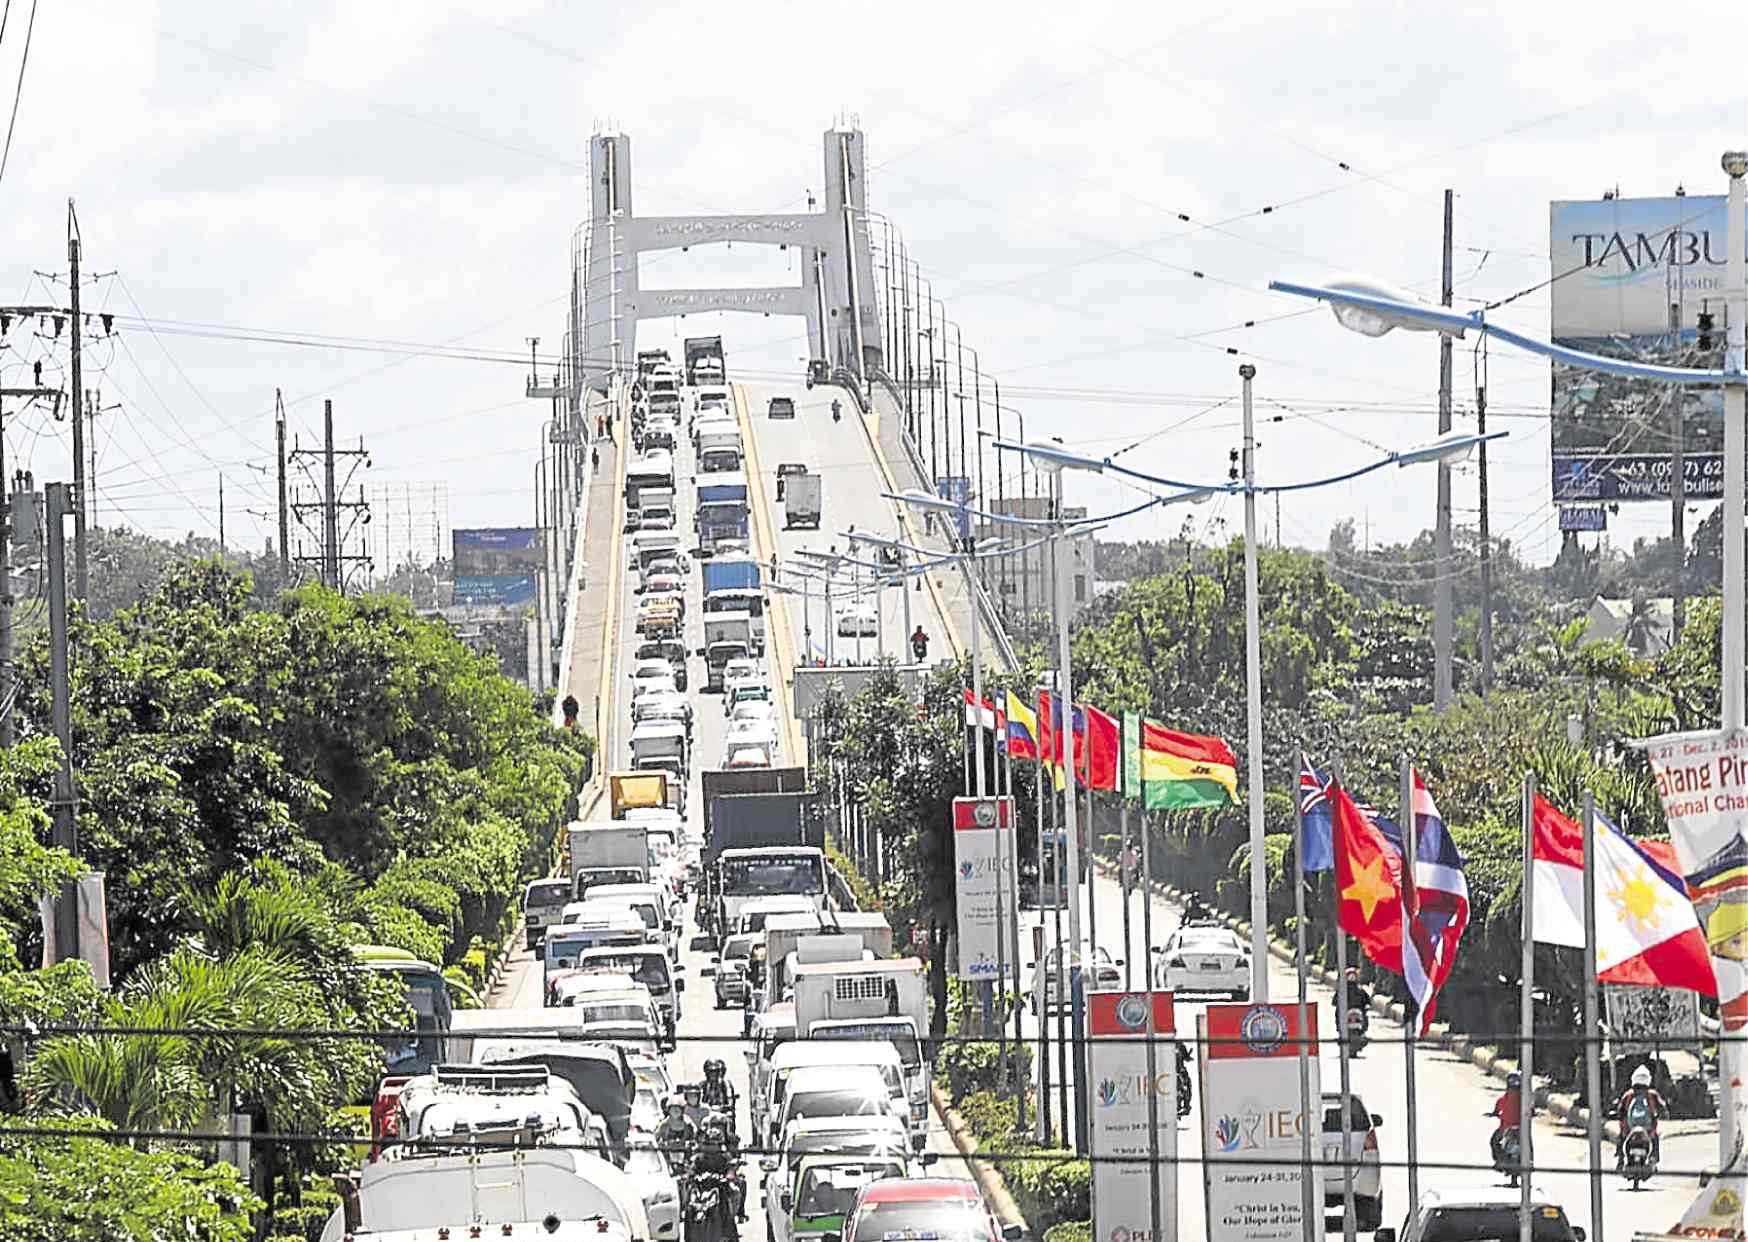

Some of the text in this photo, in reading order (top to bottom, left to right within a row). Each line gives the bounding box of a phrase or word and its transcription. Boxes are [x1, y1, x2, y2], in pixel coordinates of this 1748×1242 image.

[1572, 230, 1748, 272] TAMBU
[1652, 462, 1699, 476] (097)
[1714, 794, 1748, 812] Cha
[969, 963, 1011, 974] SMAT
[1269, 1110, 1314, 1138] IEC
[1225, 1174, 1258, 1184] January
[1290, 1171, 1302, 1182] 20
